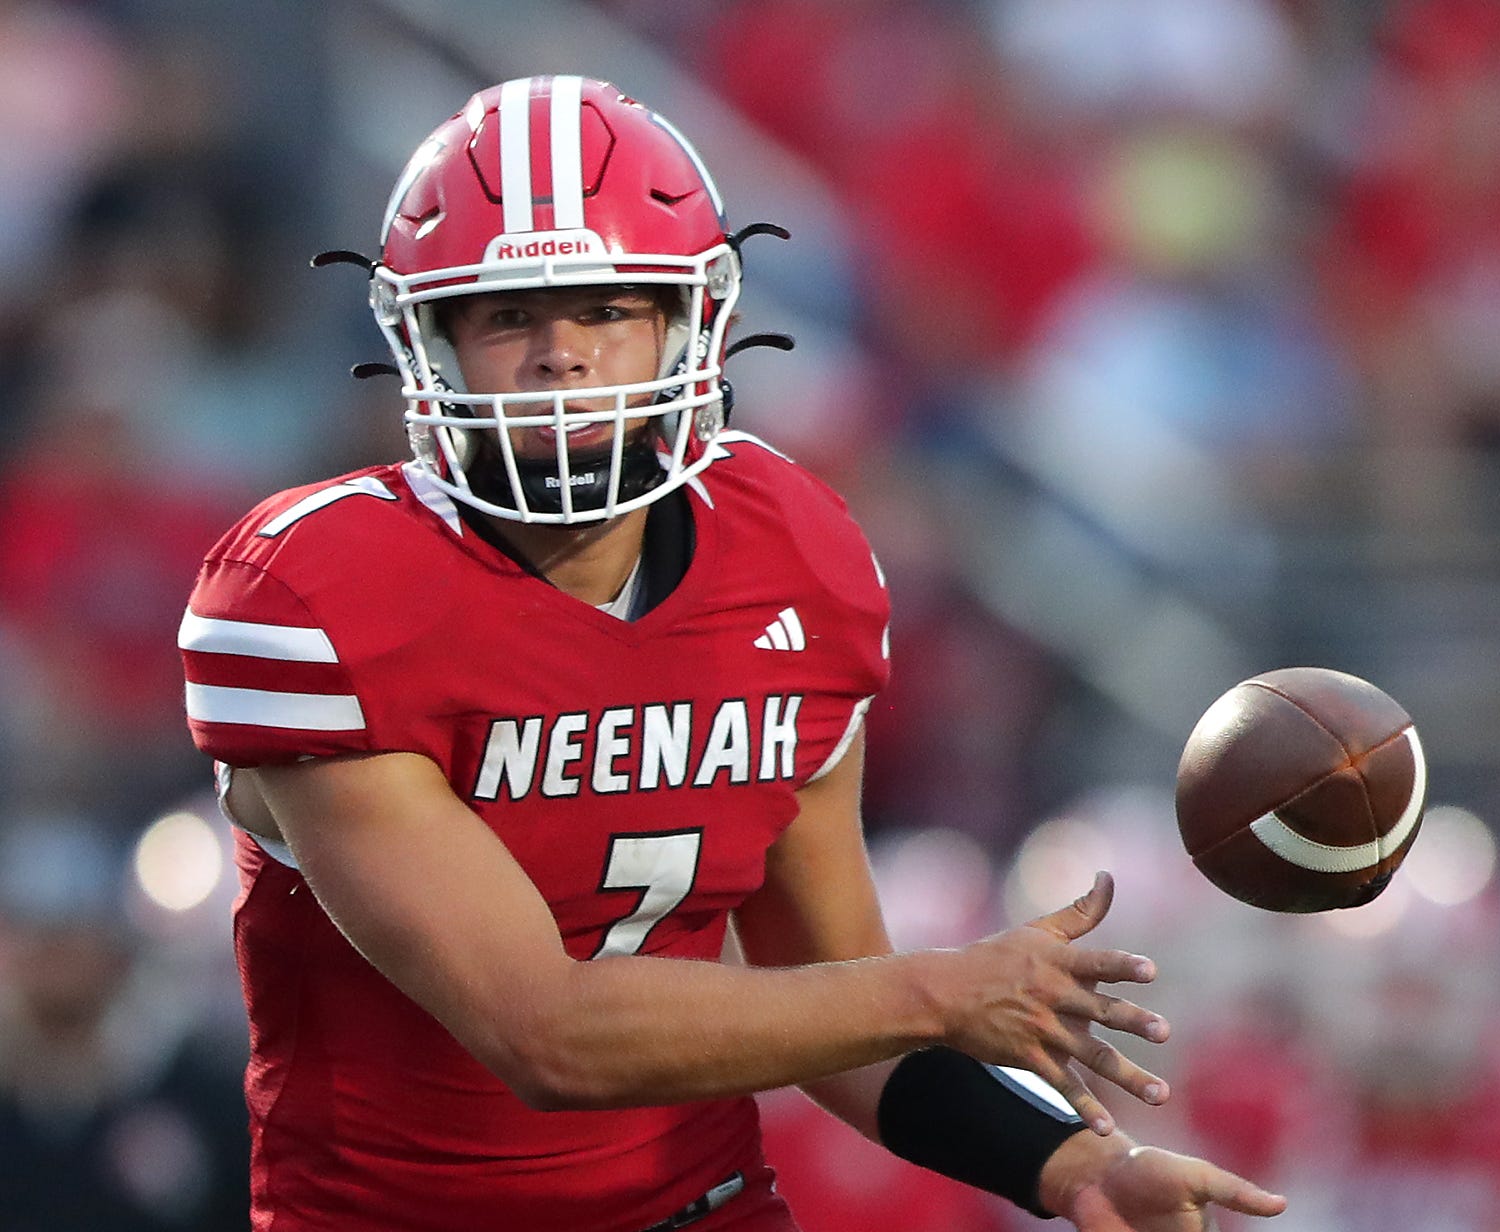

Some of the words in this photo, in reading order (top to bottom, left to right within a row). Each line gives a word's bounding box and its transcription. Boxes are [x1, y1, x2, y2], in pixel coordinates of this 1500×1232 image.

[497, 239, 591, 260] Riddell
[544, 472, 596, 488] Ridell
[472, 693, 803, 802] NEENAH
[591, 826, 705, 958] 7
